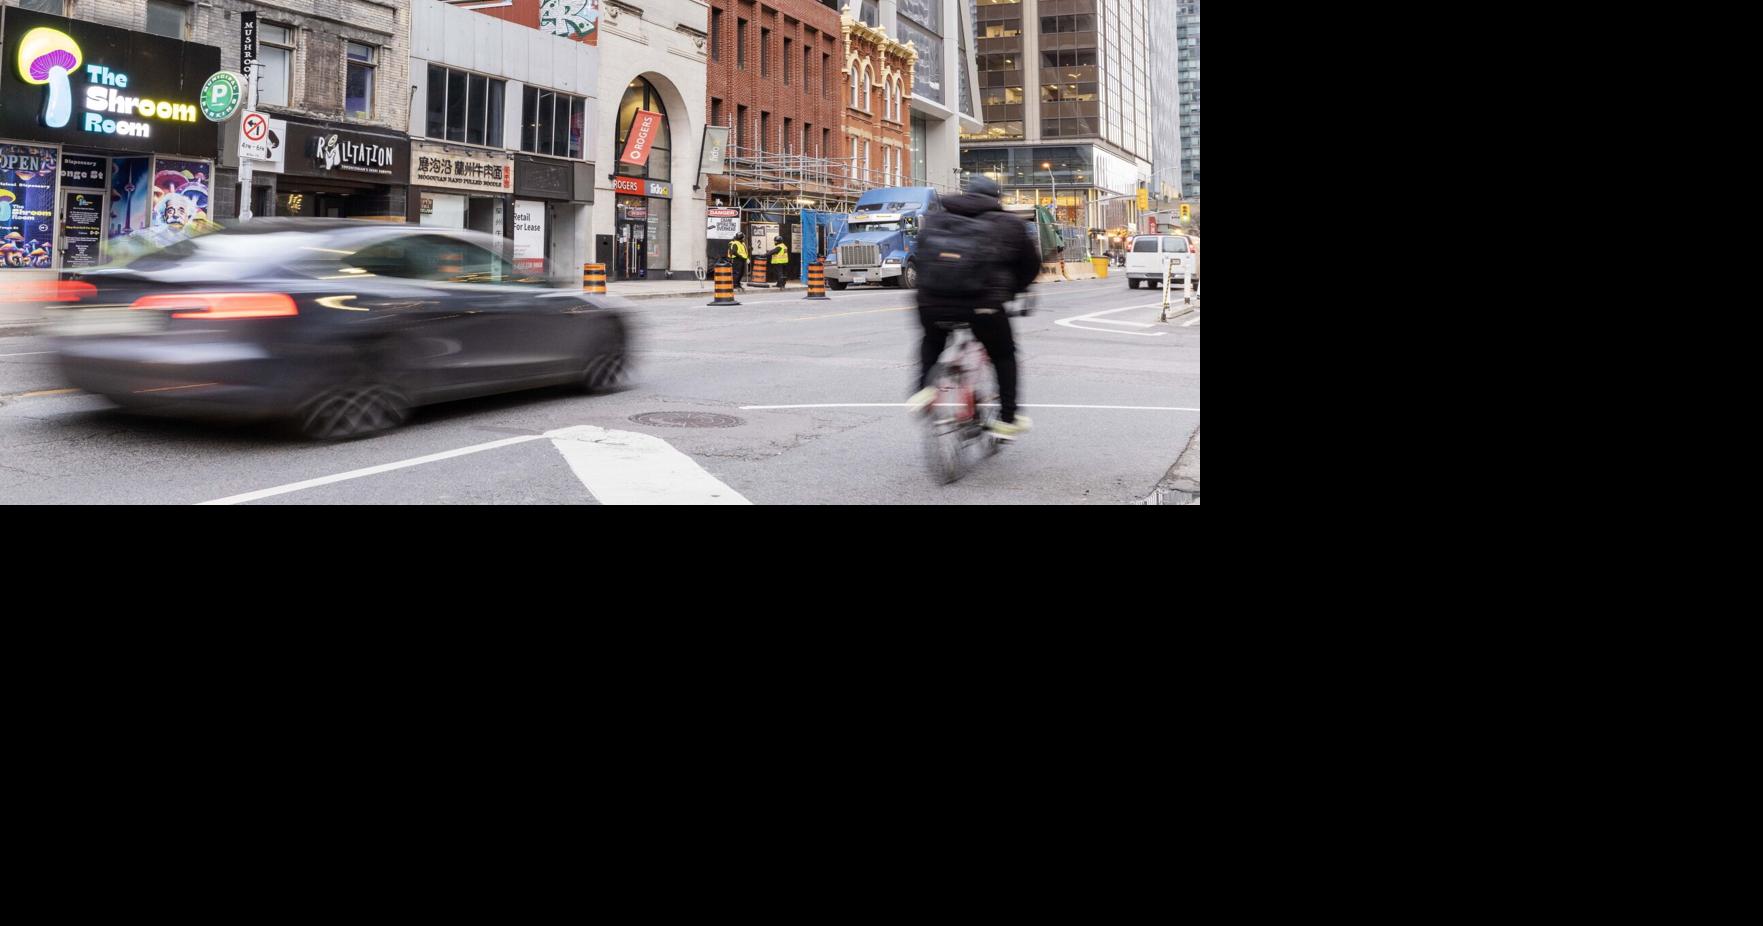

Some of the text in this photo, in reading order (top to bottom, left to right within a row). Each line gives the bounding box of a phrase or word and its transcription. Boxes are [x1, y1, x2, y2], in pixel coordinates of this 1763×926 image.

[86, 64, 128, 88] The
[203, 74, 237, 93] MUNICIPAL
[211, 84, 228, 104] P
[86, 86, 197, 122] Shroom
[202, 98, 237, 118] PARKING
[85, 112, 150, 138] Room
[634, 116, 653, 150] ROGERS
[0, 154, 40, 171] OPEN
[64, 158, 97, 167] Dispensary
[463, 178, 482, 186] PULLED
[613, 179, 638, 191] ROGERS
[12, 208, 52, 217] Shroom
[513, 212, 531, 222] Retail
[513, 222, 541, 232] For Lease
